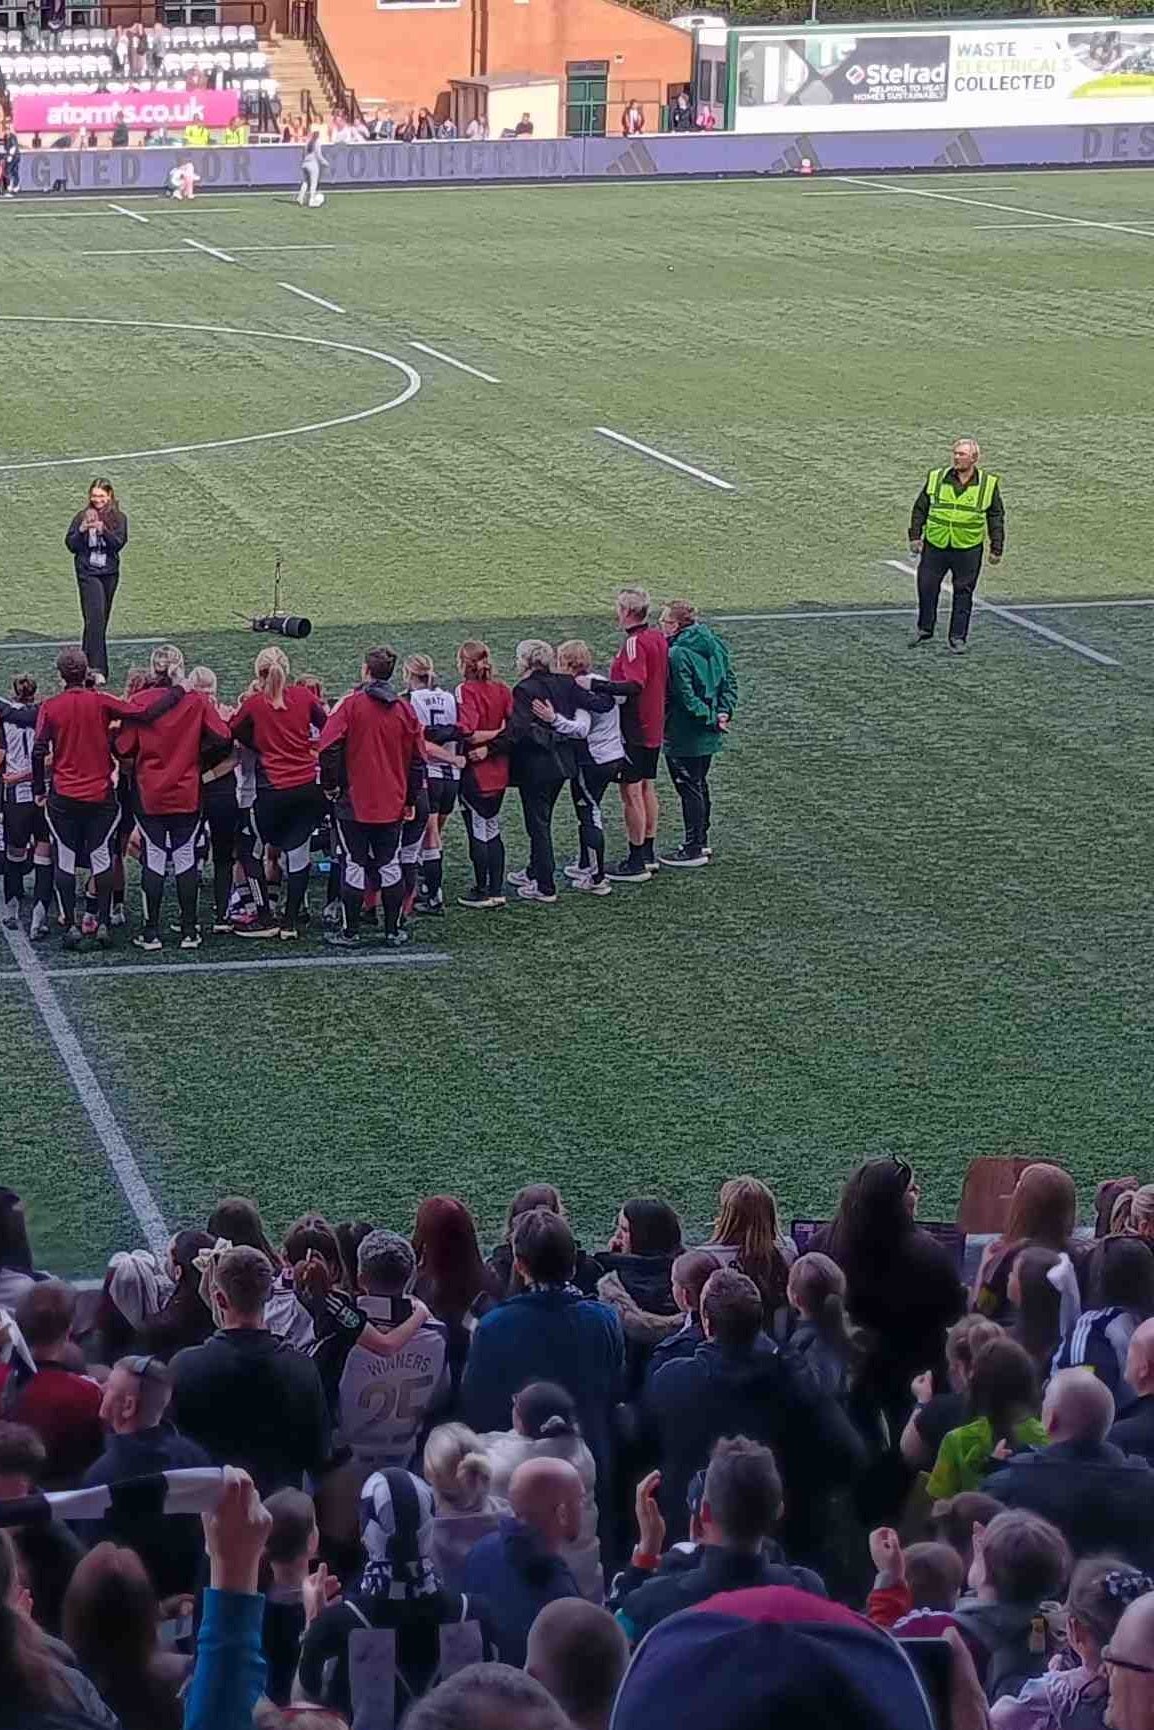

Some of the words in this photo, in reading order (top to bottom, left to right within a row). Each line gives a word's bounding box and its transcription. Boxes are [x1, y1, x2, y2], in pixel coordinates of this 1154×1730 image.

[957, 42, 1017, 57] WASTE
[866, 63, 946, 85] Stelrad
[956, 59, 1072, 75] ELECTRICALS
[954, 75, 1055, 92] COLLECTED
